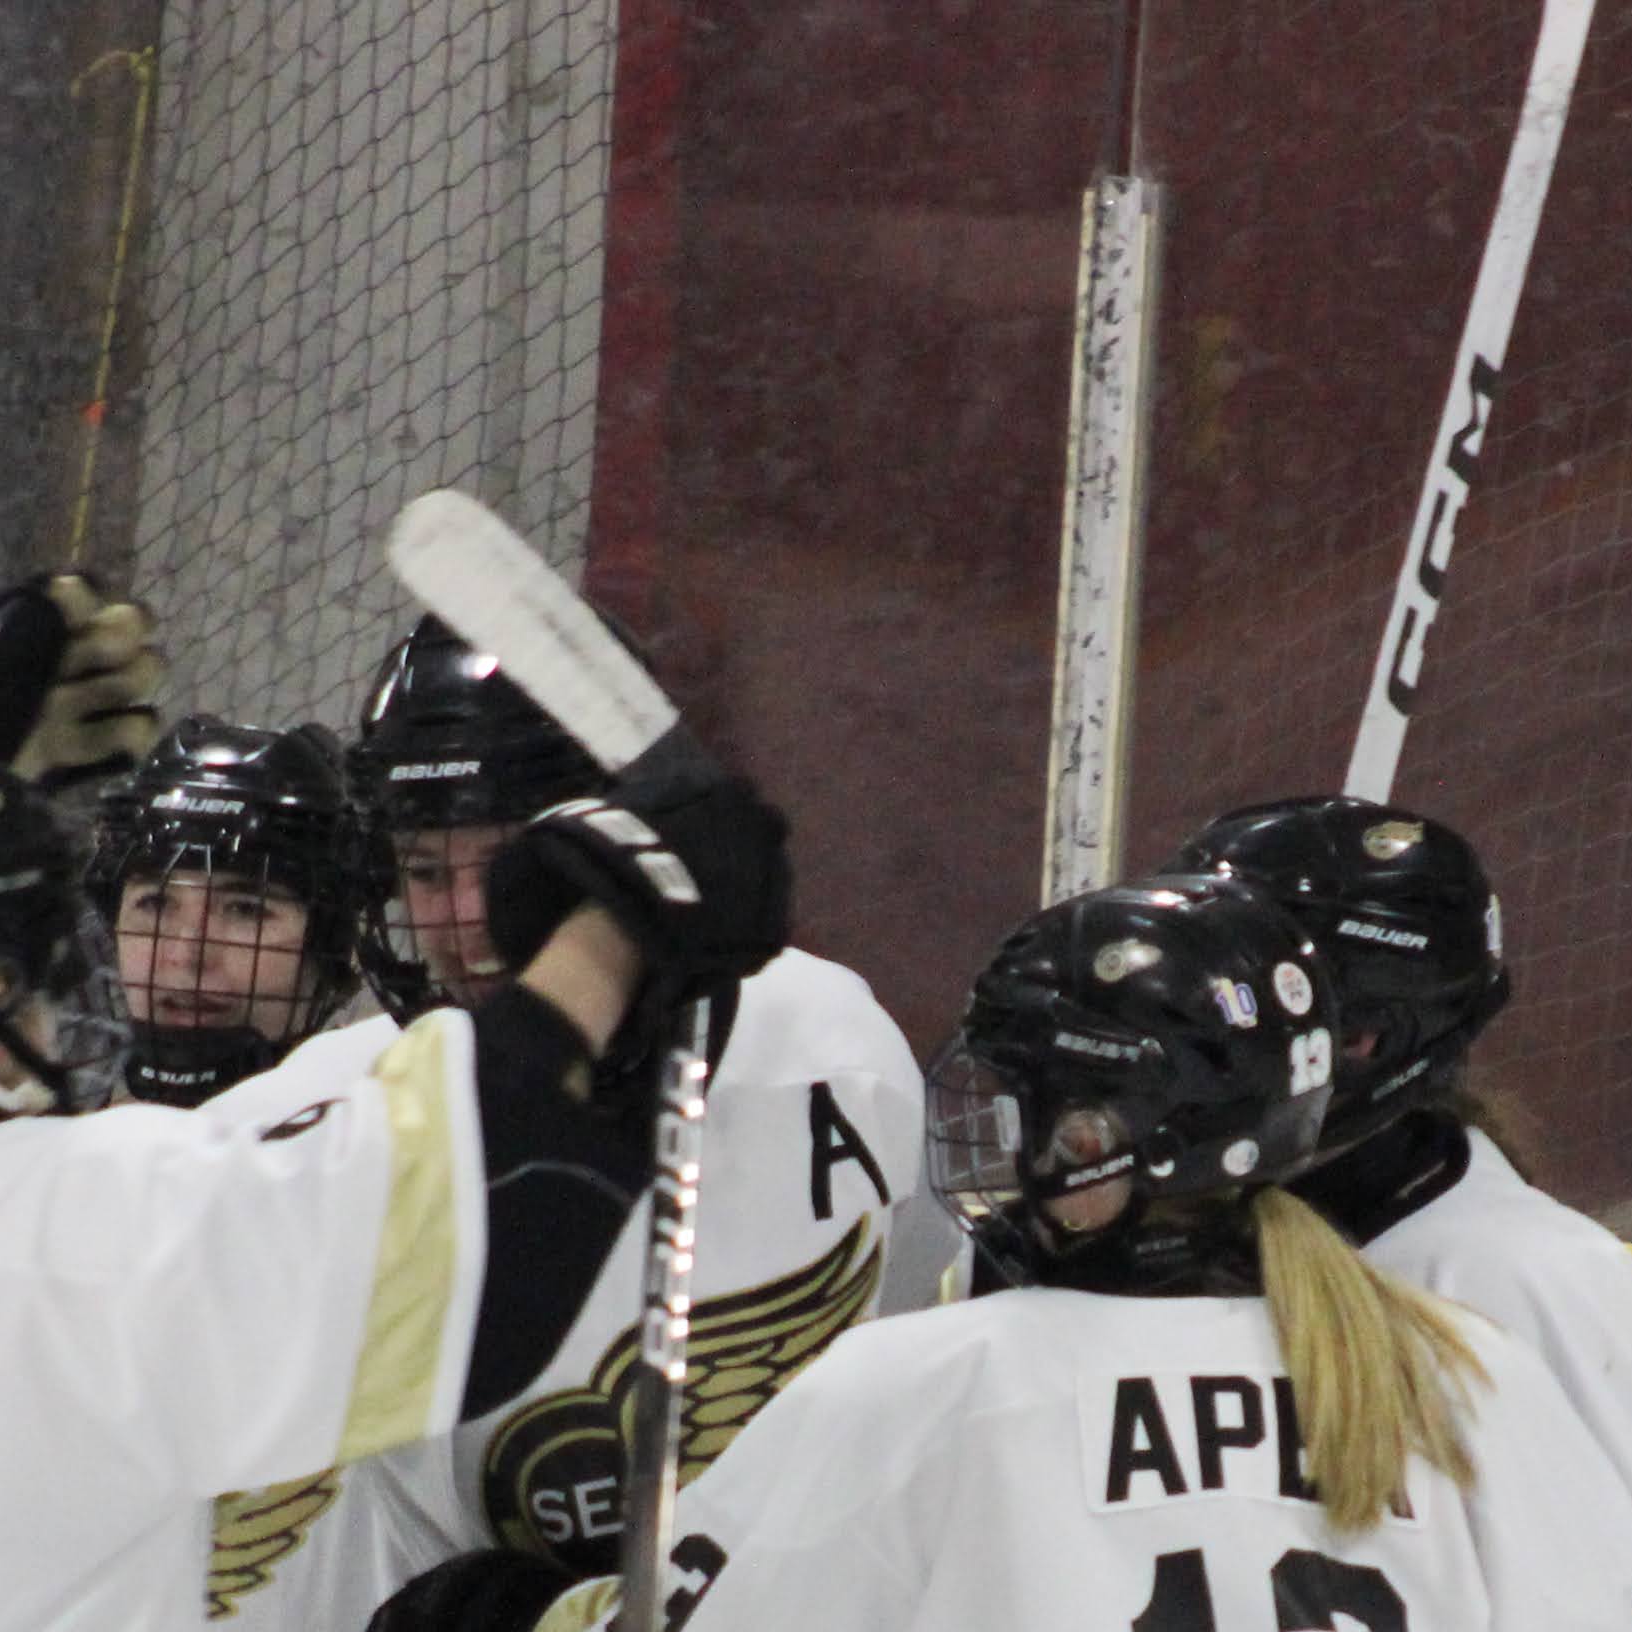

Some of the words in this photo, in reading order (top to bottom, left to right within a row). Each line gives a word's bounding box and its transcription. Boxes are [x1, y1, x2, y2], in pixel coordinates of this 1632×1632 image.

[1388, 353, 1502, 716] CCM
[388, 761, 481, 781] BAUER
[151, 792, 246, 815] BAUER
[1338, 919, 1429, 950] BAUER
[809, 1079, 892, 1221] A
[532, 1475, 629, 1543] SE
